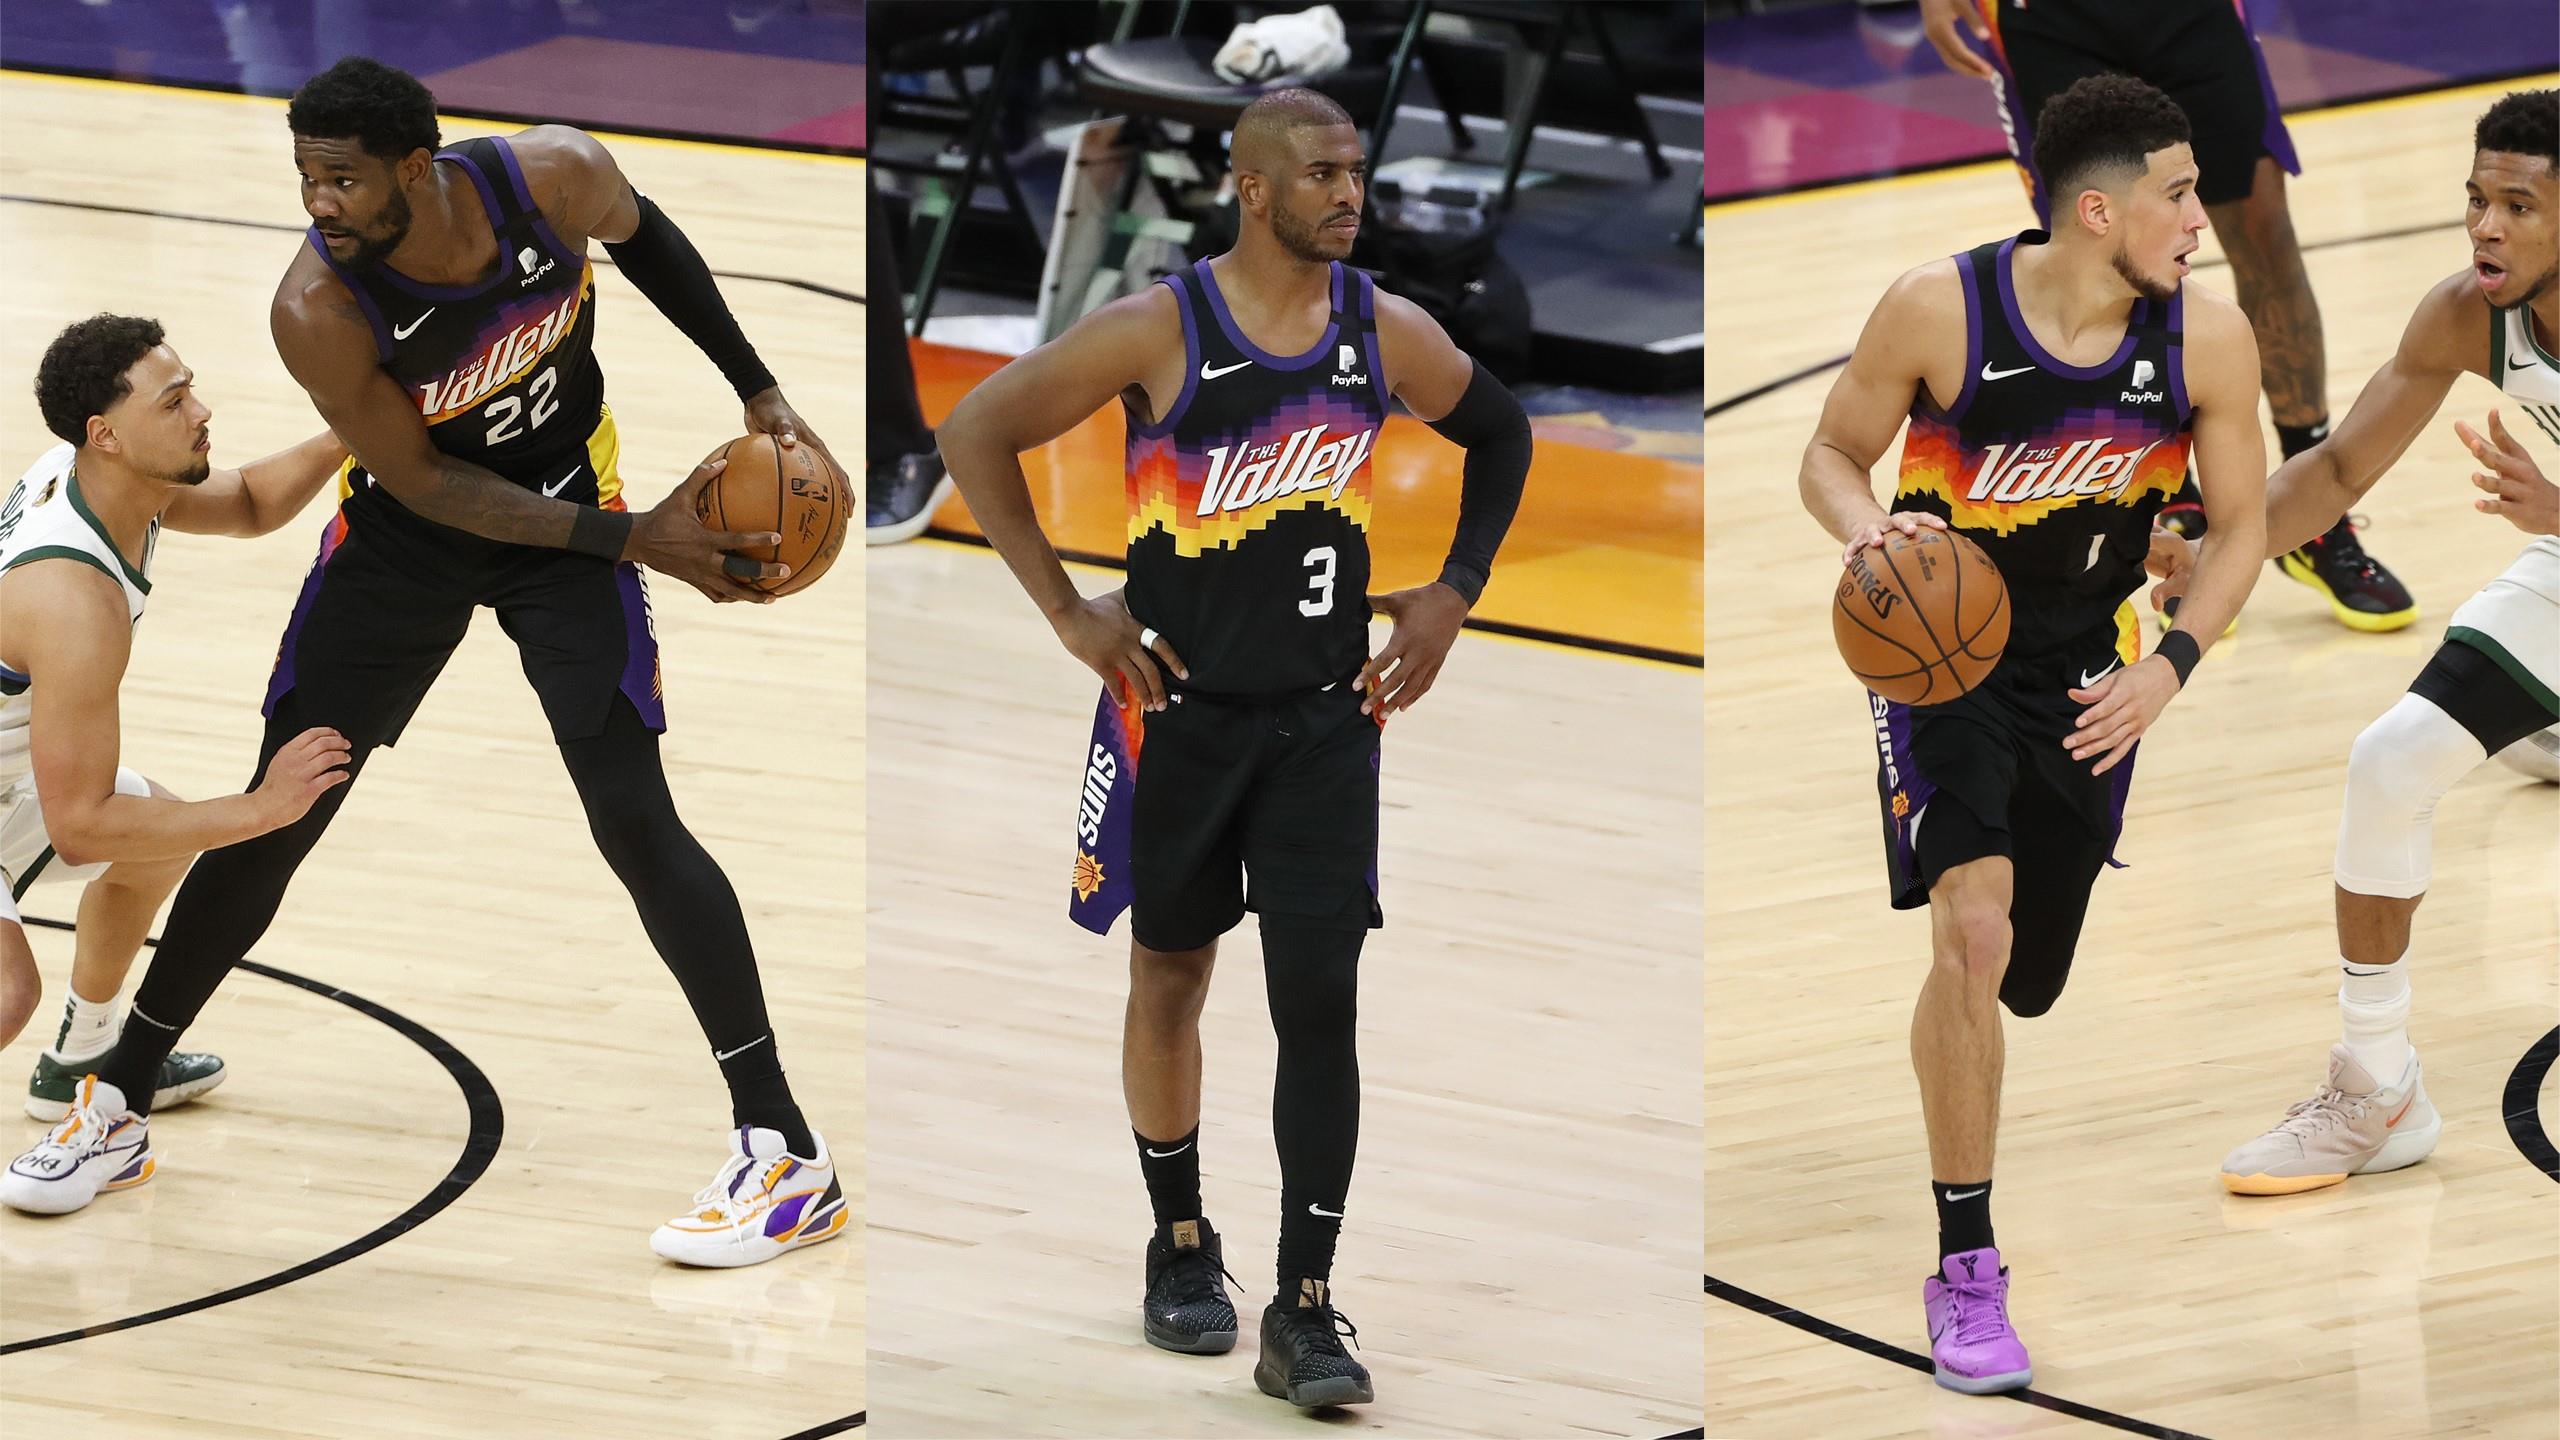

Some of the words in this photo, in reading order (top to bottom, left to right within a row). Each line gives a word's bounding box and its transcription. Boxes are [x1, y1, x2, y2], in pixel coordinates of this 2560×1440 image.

[521, 259, 555, 287] PayPal
[420, 296, 572, 416] Valley
[459, 354, 485, 380] THE
[1332, 374, 1367, 387] PayPal
[484, 366, 560, 446] 22
[2120, 391, 2163, 404] PayPal
[1196, 423, 1372, 517] Valley
[1248, 441, 1281, 463] THE
[1967, 437, 2164, 503] Valley
[2026, 446, 2060, 461] THE
[1298, 546, 1337, 617] 3
[1850, 552, 1903, 619] SPALDI
[1873, 695, 1899, 789] SUNS
[1077, 743, 1117, 847] SUNS
